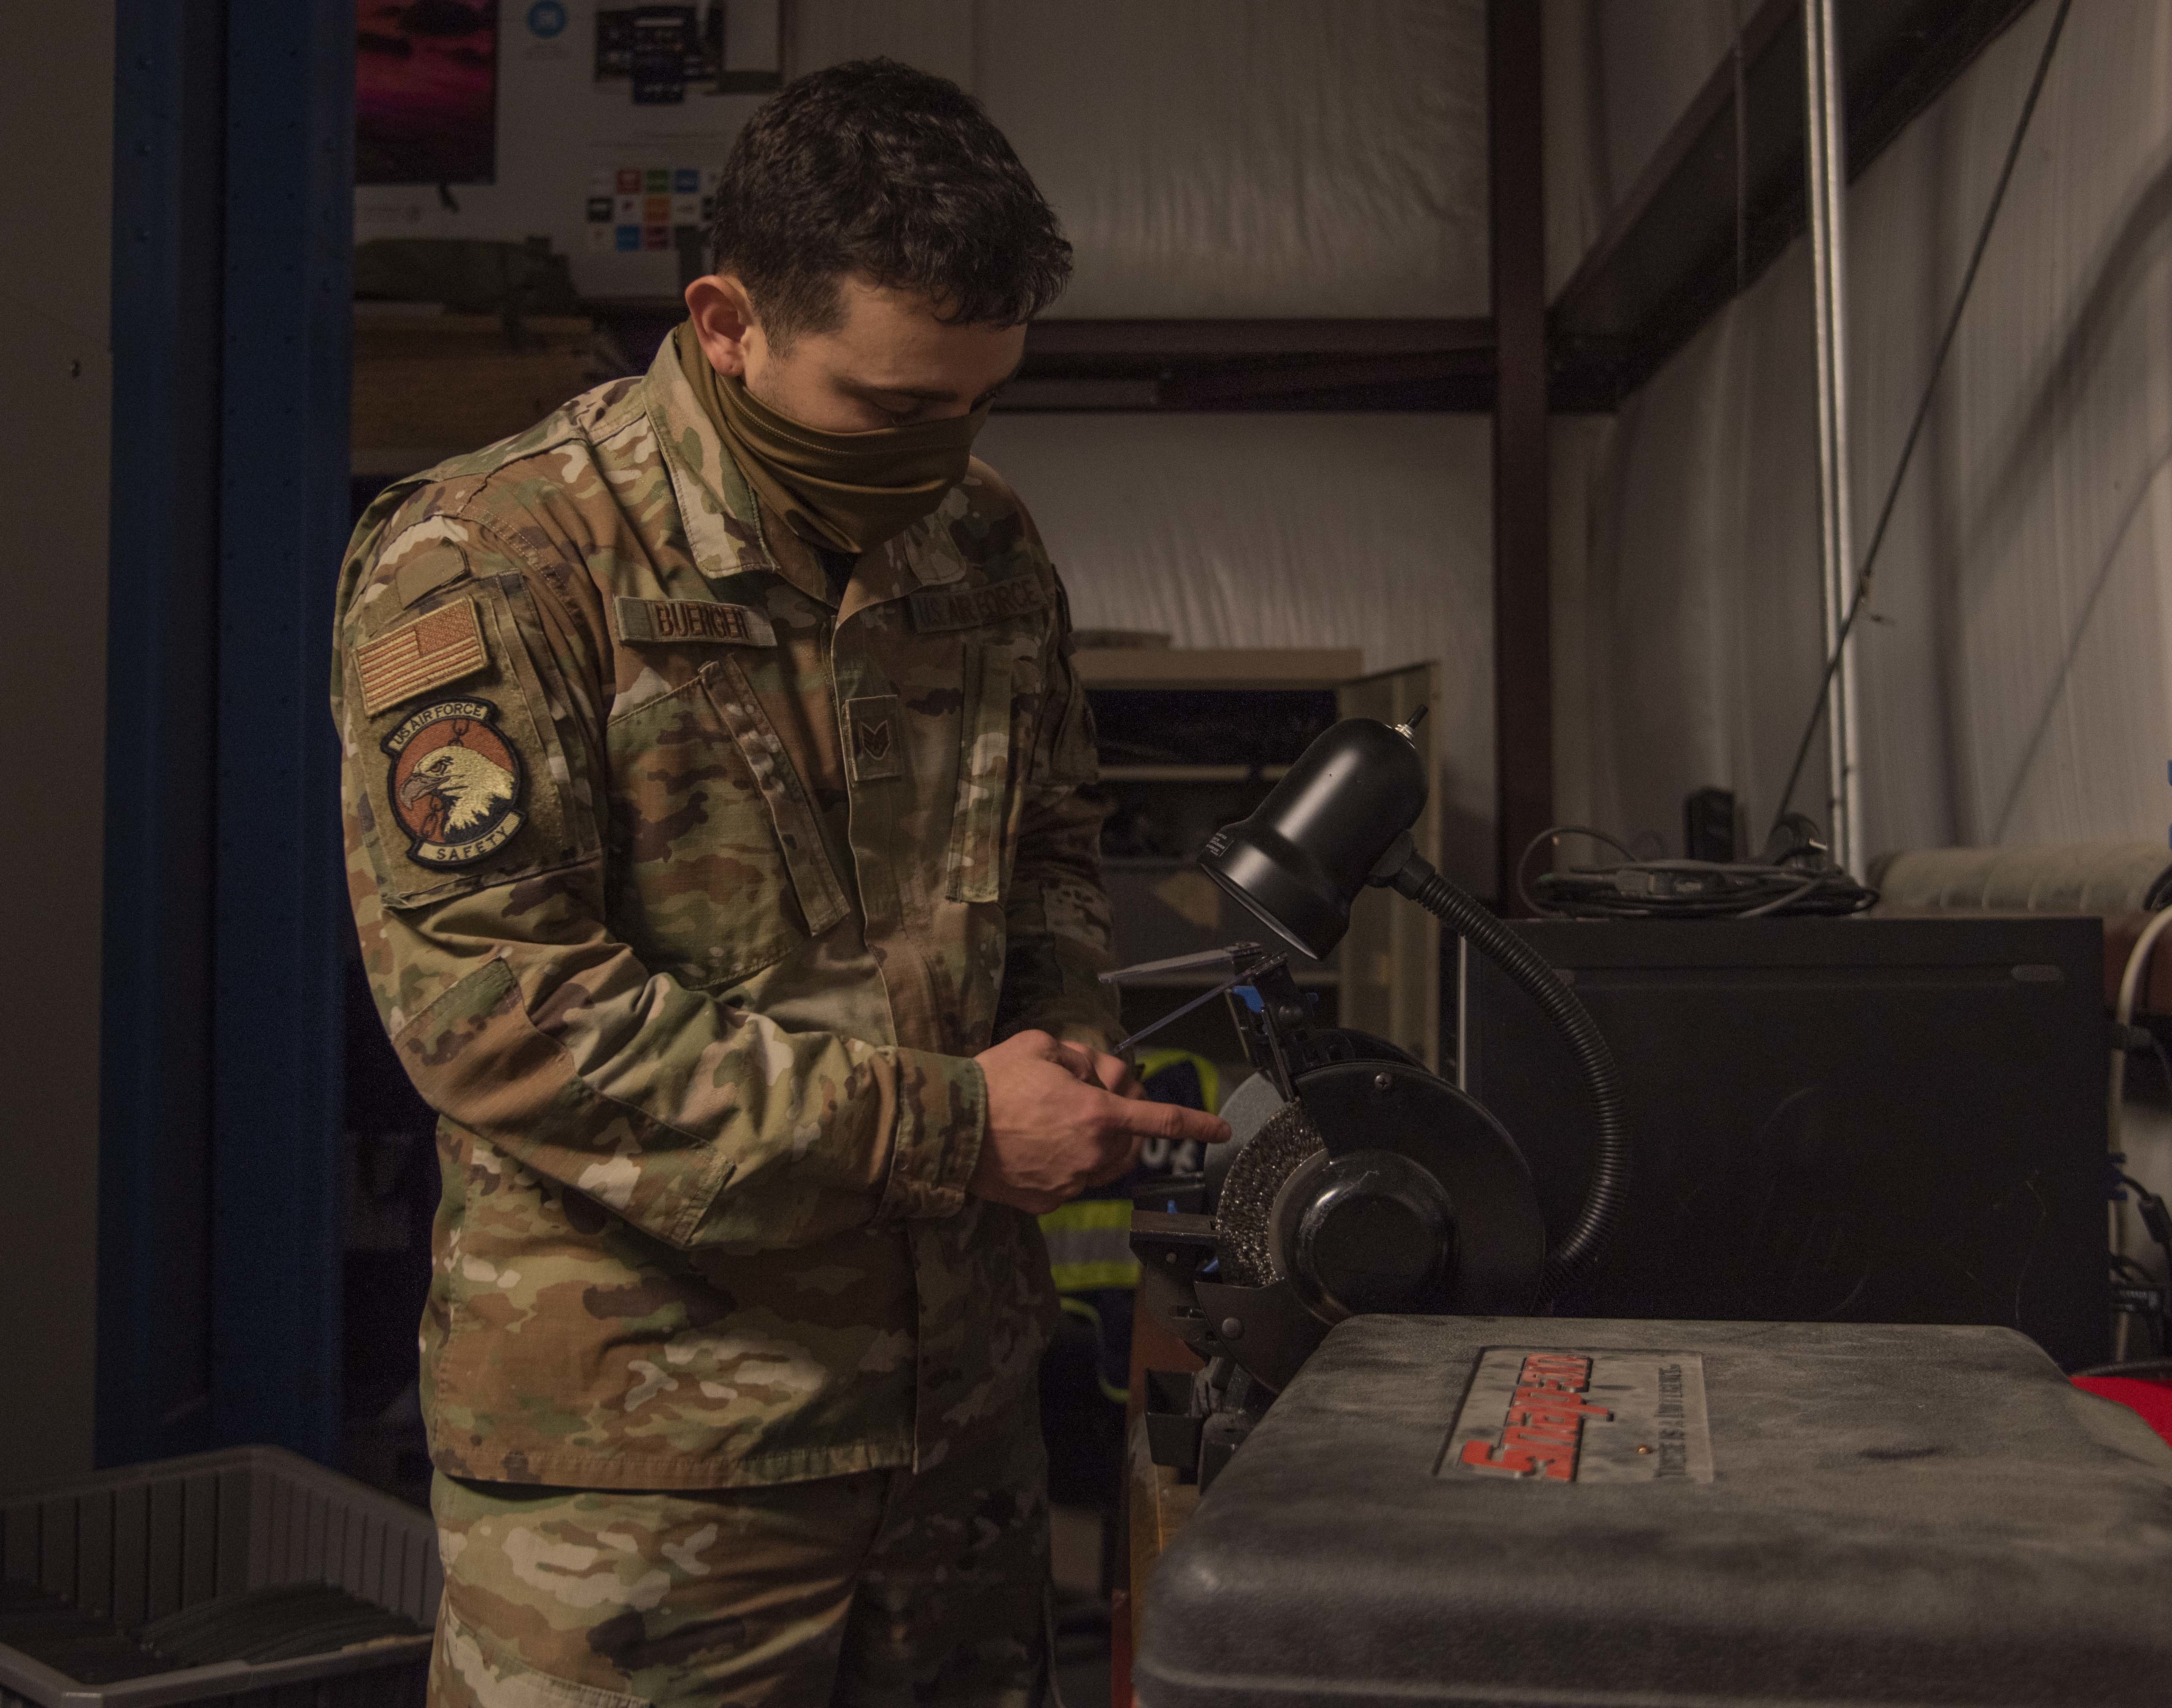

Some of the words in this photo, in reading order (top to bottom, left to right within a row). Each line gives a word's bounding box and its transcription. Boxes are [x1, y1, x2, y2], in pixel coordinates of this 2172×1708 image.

[974, 580, 1039, 616] FORCE
[656, 603, 750, 639] BUERGER
[394, 729, 409, 745] US
[409, 712, 432, 731] AIR
[435, 704, 481, 719] FORCE
[437, 826, 508, 860] SAFETY
